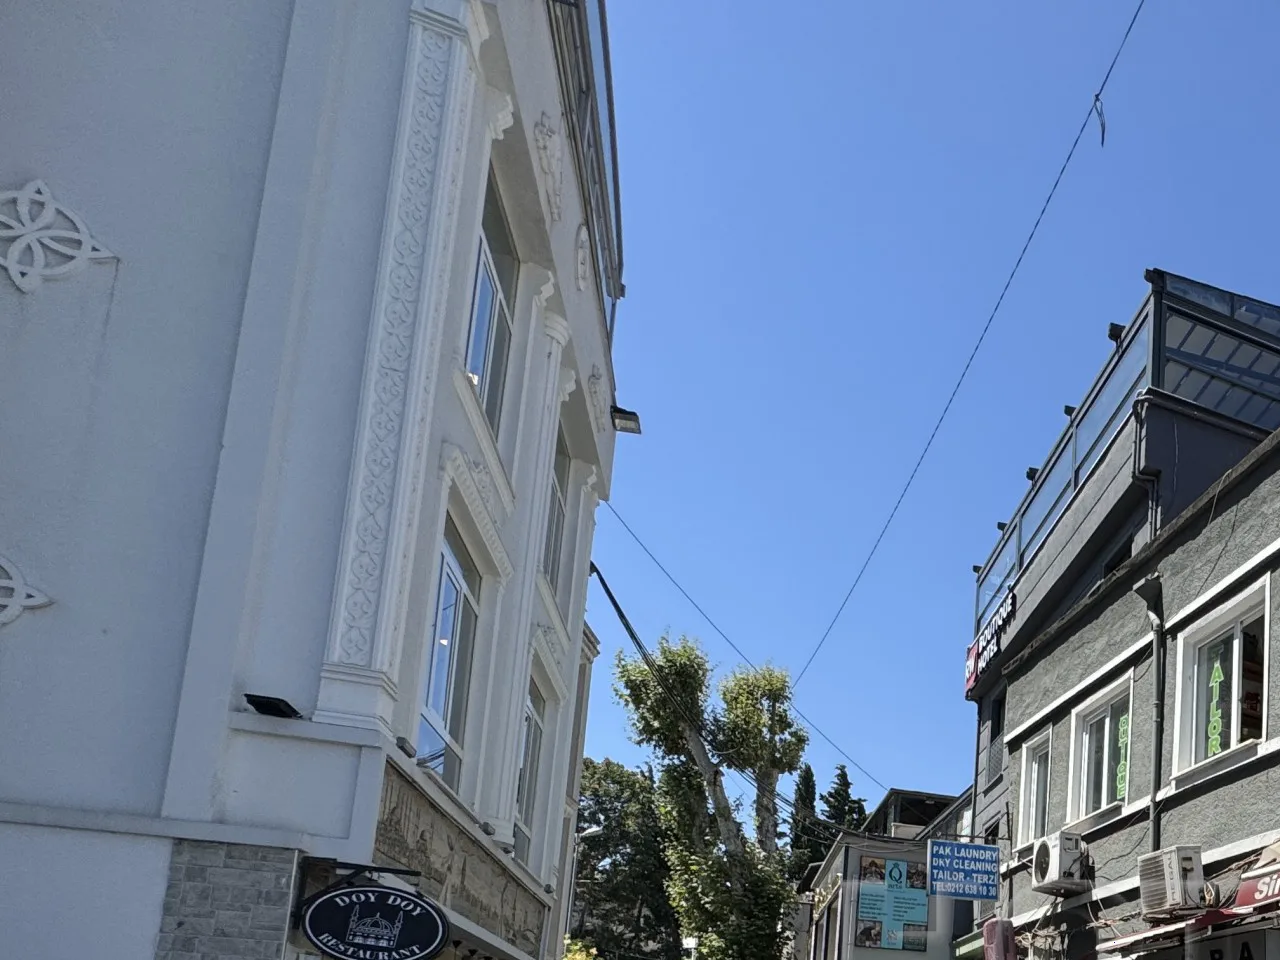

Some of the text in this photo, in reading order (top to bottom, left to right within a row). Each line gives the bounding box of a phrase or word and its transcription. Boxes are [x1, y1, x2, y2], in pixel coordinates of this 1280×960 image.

[933, 846, 997, 861] PAK LAUNDRY
[953, 860, 997, 872] CLEANING
[932, 870, 964, 882] TAILOR
[334, 892, 426, 916] DOY DOY
[318, 932, 421, 960] RESTAURANT
